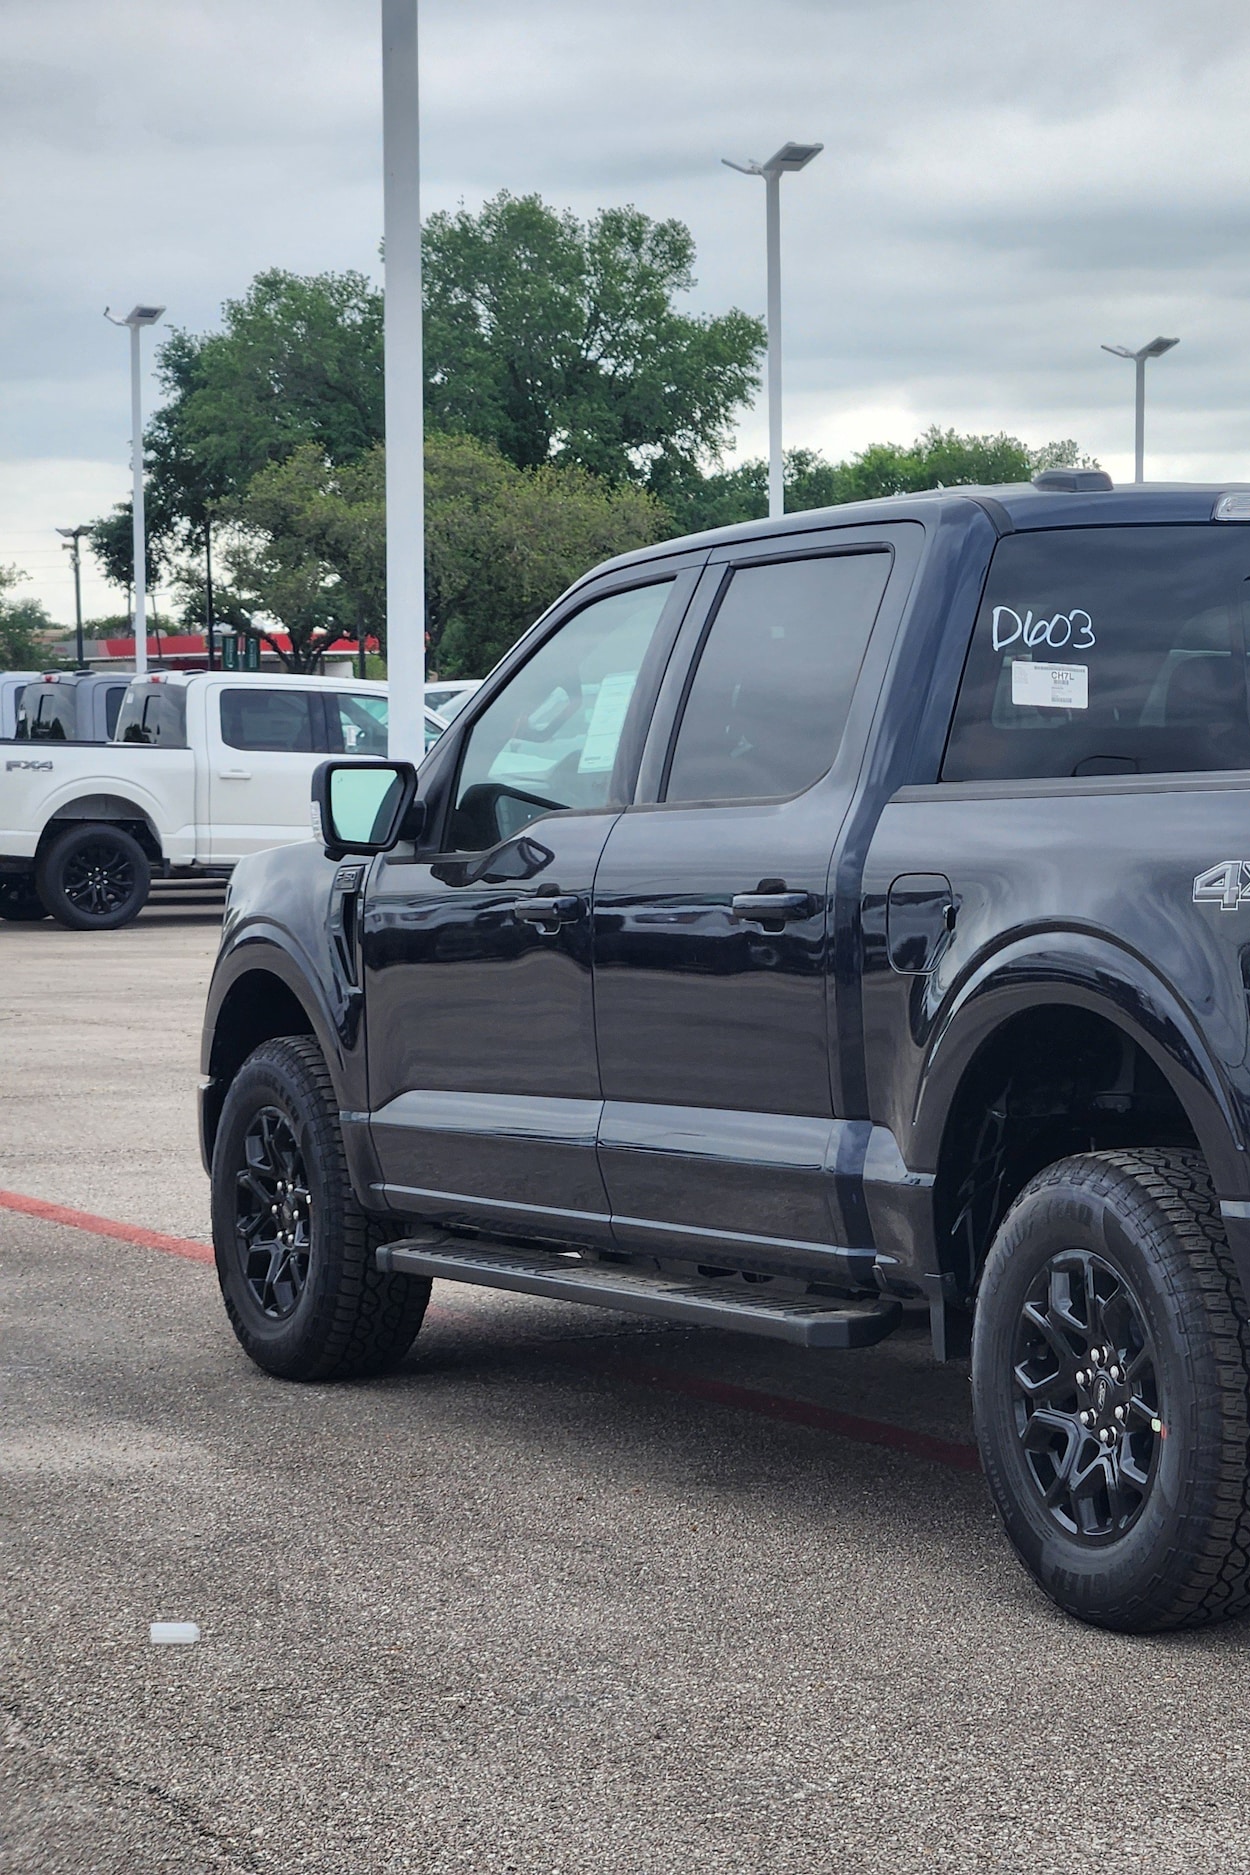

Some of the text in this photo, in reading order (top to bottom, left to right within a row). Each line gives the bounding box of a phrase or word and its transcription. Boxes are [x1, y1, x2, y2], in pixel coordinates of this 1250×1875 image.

[992, 605, 1096, 651] D603
[1051, 671, 1074, 681] CH7L
[6, 760, 53, 771] FX4
